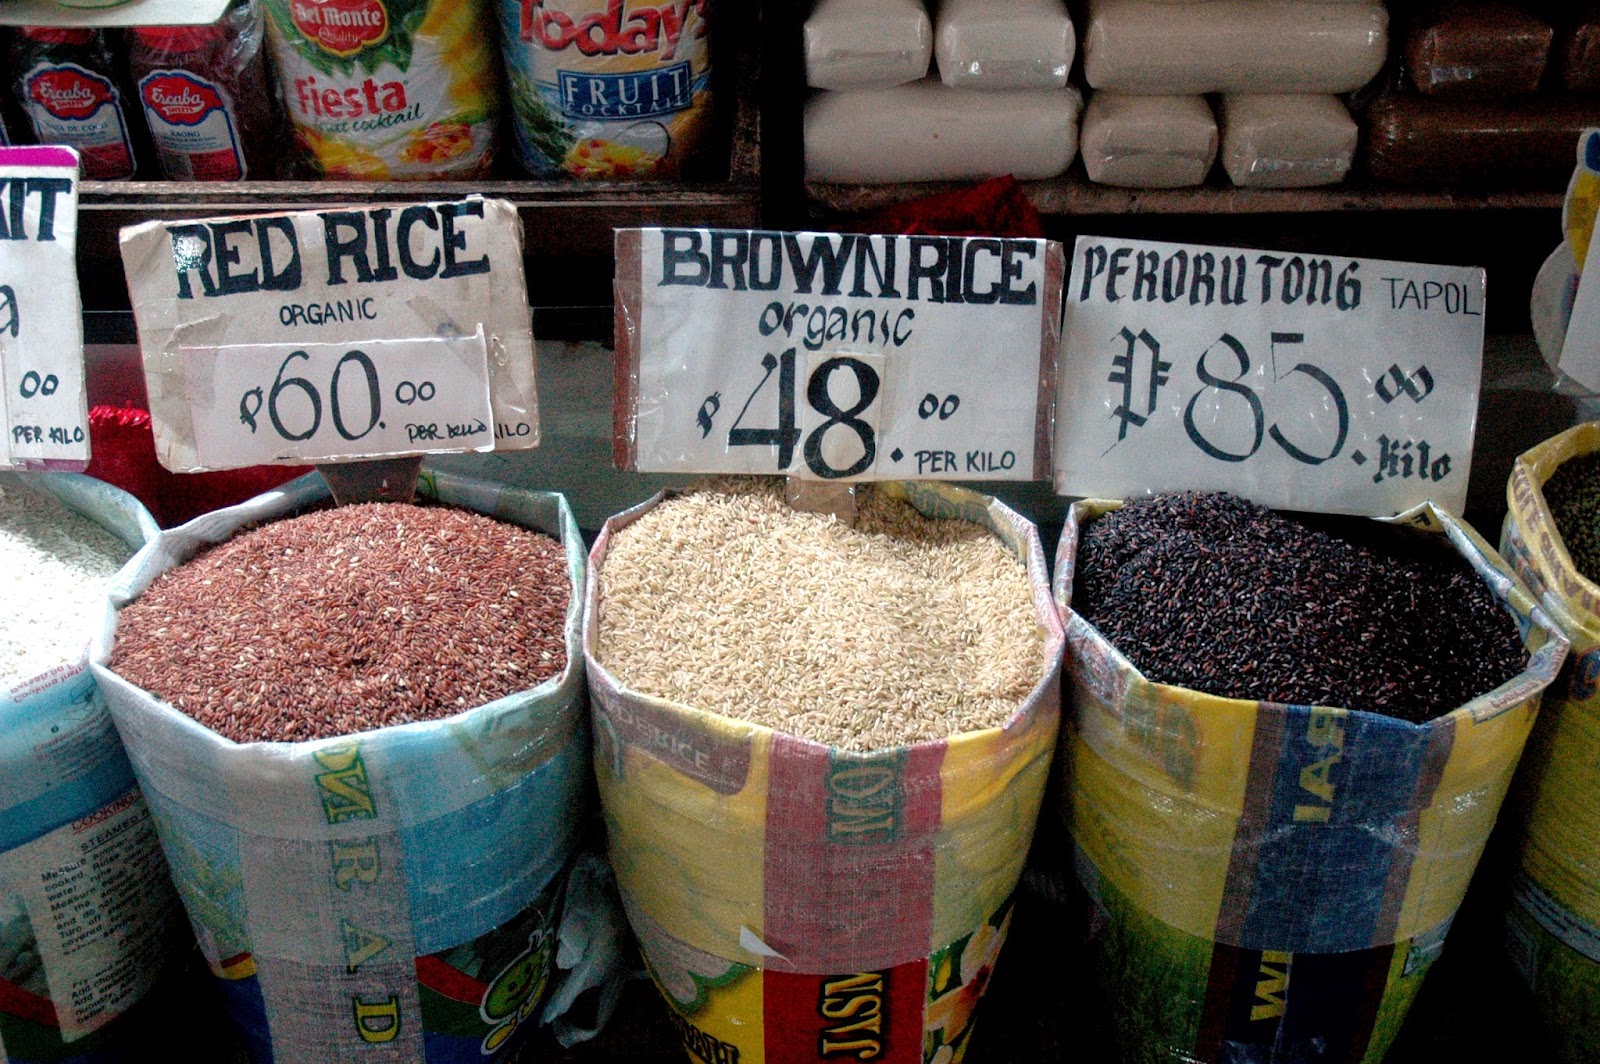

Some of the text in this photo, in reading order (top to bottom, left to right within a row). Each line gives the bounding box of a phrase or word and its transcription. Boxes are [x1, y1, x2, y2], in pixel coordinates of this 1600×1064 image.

[295, 3, 381, 27] Del Monte
[318, 27, 359, 42] Quality
[40, 81, 96, 100] Escaba
[152, 87, 204, 104] Escaba
[294, 75, 407, 118] Fiesta
[566, 69, 685, 105] FRUIT
[353, 102, 424, 131] cocktail
[566, 95, 686, 116] COCKTAIL
[166, 201, 490, 298] RED RICE
[658, 230, 1037, 305] BROWN RICE
[1380, 277, 1481, 316] TAPOL
[280, 298, 377, 326] ORGANIC
[758, 301, 915, 351] organic
[20, 370, 59, 399] 00
[918, 393, 960, 420] 00
[13, 426, 85, 444] PER KILO
[405, 423, 445, 444] PER
[494, 422, 530, 439] ILO
[914, 449, 1016, 473] PER KILO
[72, 797, 135, 829] COOKING
[79, 818, 140, 849] STEAMED
